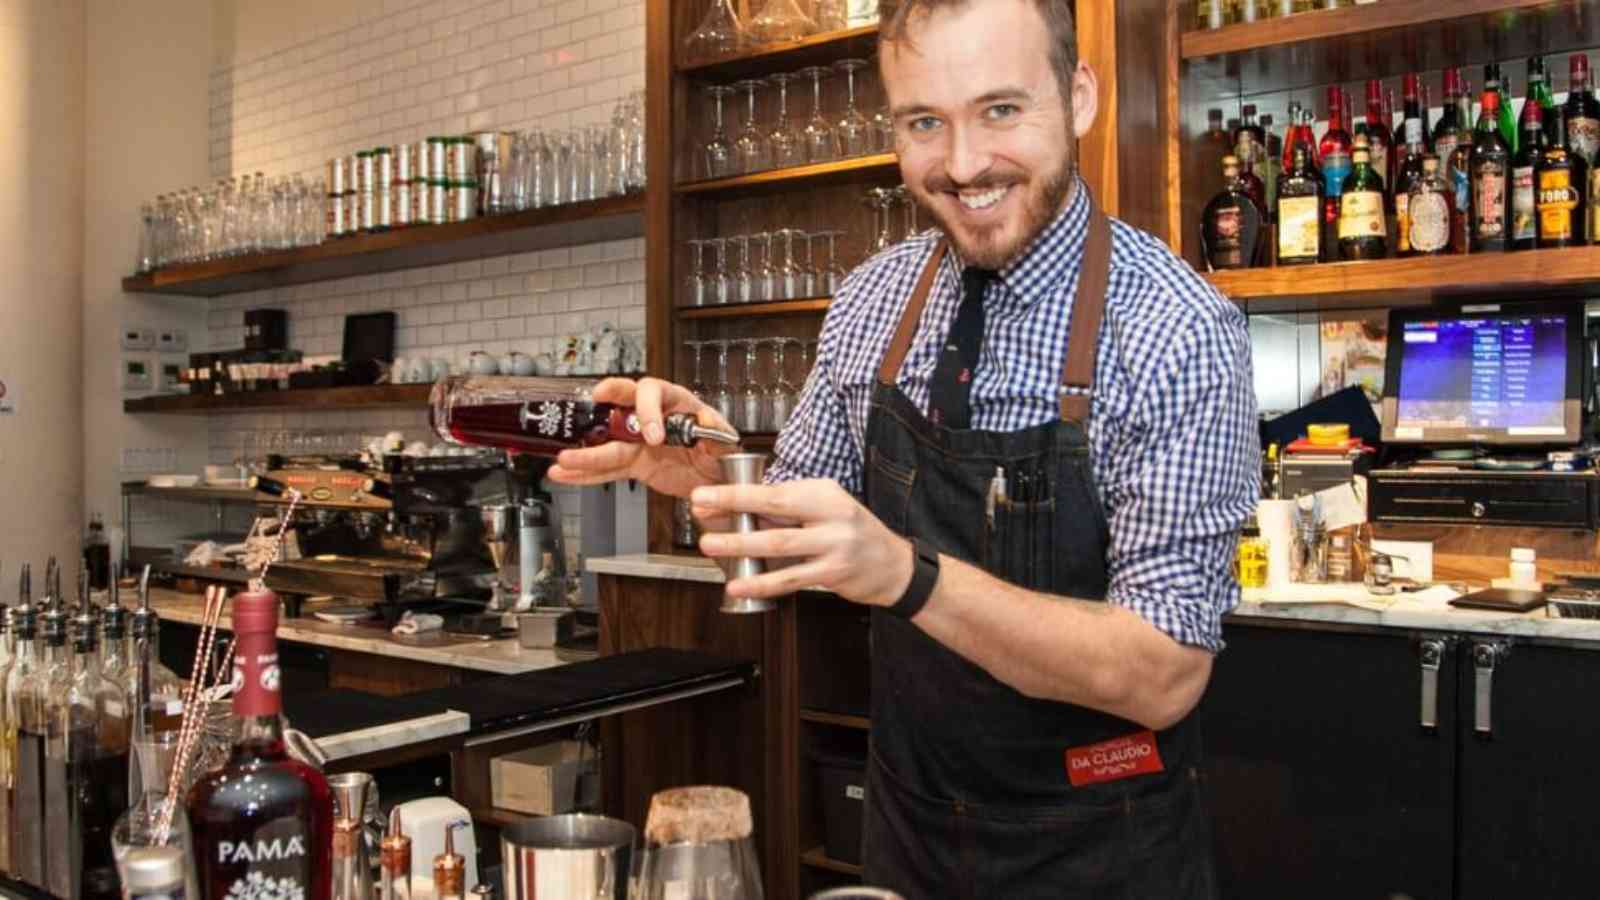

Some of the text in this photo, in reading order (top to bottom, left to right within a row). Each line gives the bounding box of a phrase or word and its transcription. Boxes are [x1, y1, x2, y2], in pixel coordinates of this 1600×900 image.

[564, 400, 574, 437] PAMA
[1072, 757, 1091, 769] DA
[1093, 743, 1151, 764] CLAUDIO
[218, 835, 304, 862] PAMA
